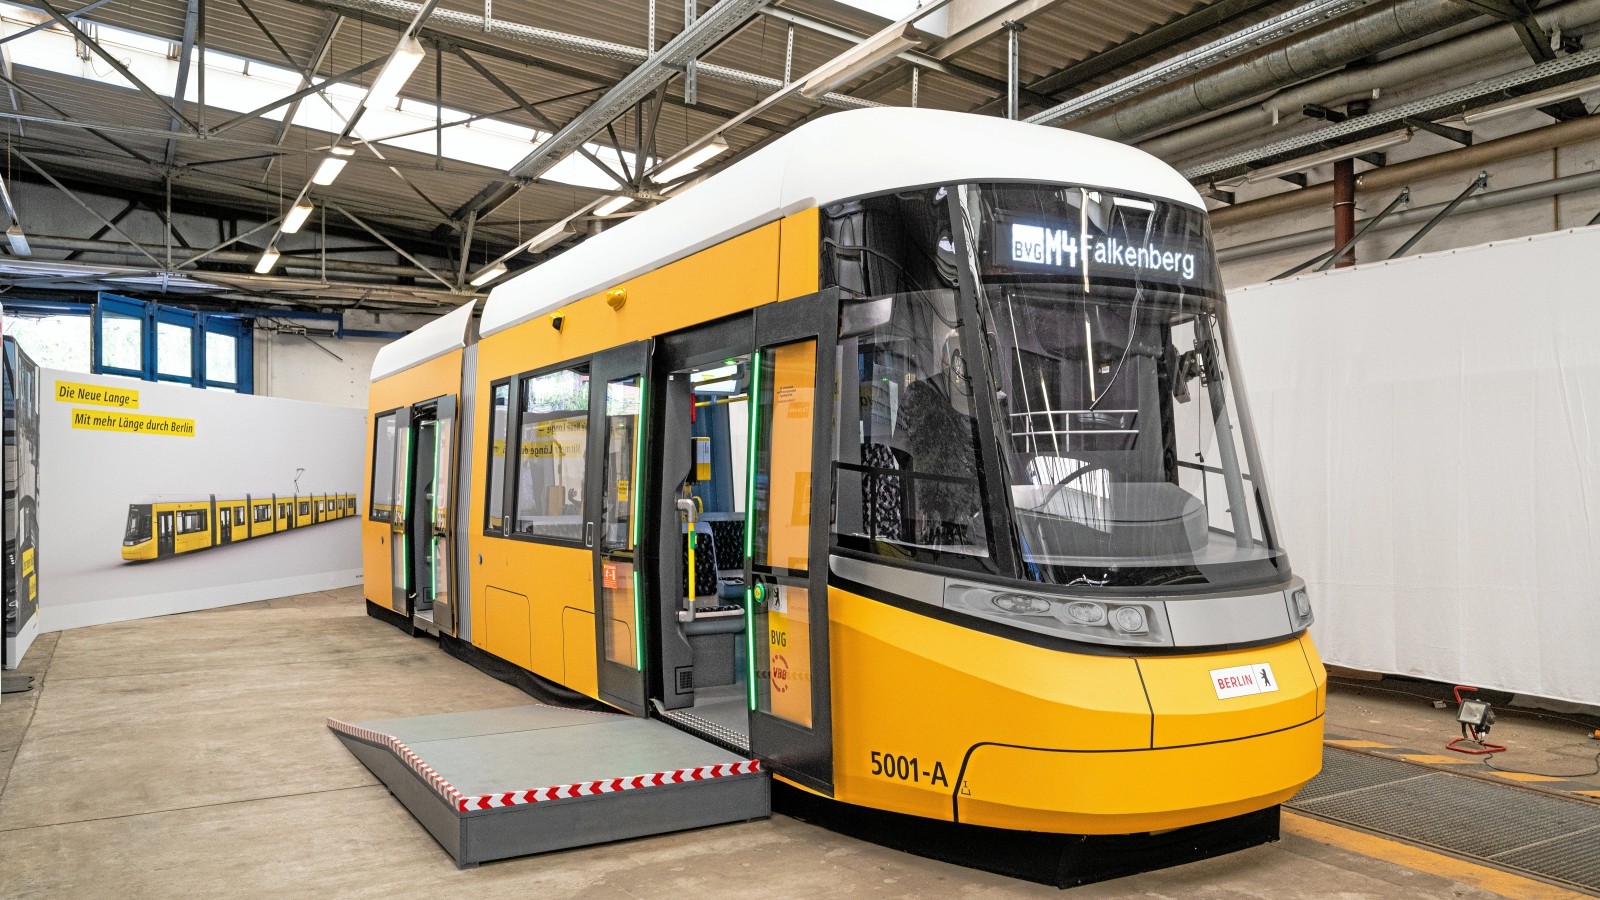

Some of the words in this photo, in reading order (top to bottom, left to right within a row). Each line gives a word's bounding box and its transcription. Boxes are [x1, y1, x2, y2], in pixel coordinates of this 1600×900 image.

[1014, 240, 1042, 261] BVG
[1045, 227, 1078, 268] M4
[1080, 234, 1195, 280] Falkenberg
[59, 385, 75, 398] Die
[77, 388, 101, 401] Neue
[103, 391, 130, 406] Lange
[74, 413, 91, 425] Mit
[93, 415, 117, 427] mehr
[118, 417, 144, 431] Länge
[146, 419, 169, 431] durch
[170, 421, 193, 433] Berlin
[770, 629, 787, 647] BVG
[773, 666, 787, 680] VBB
[1217, 674, 1253, 690] BERLIN
[870, 750, 949, 788] 5001-A
